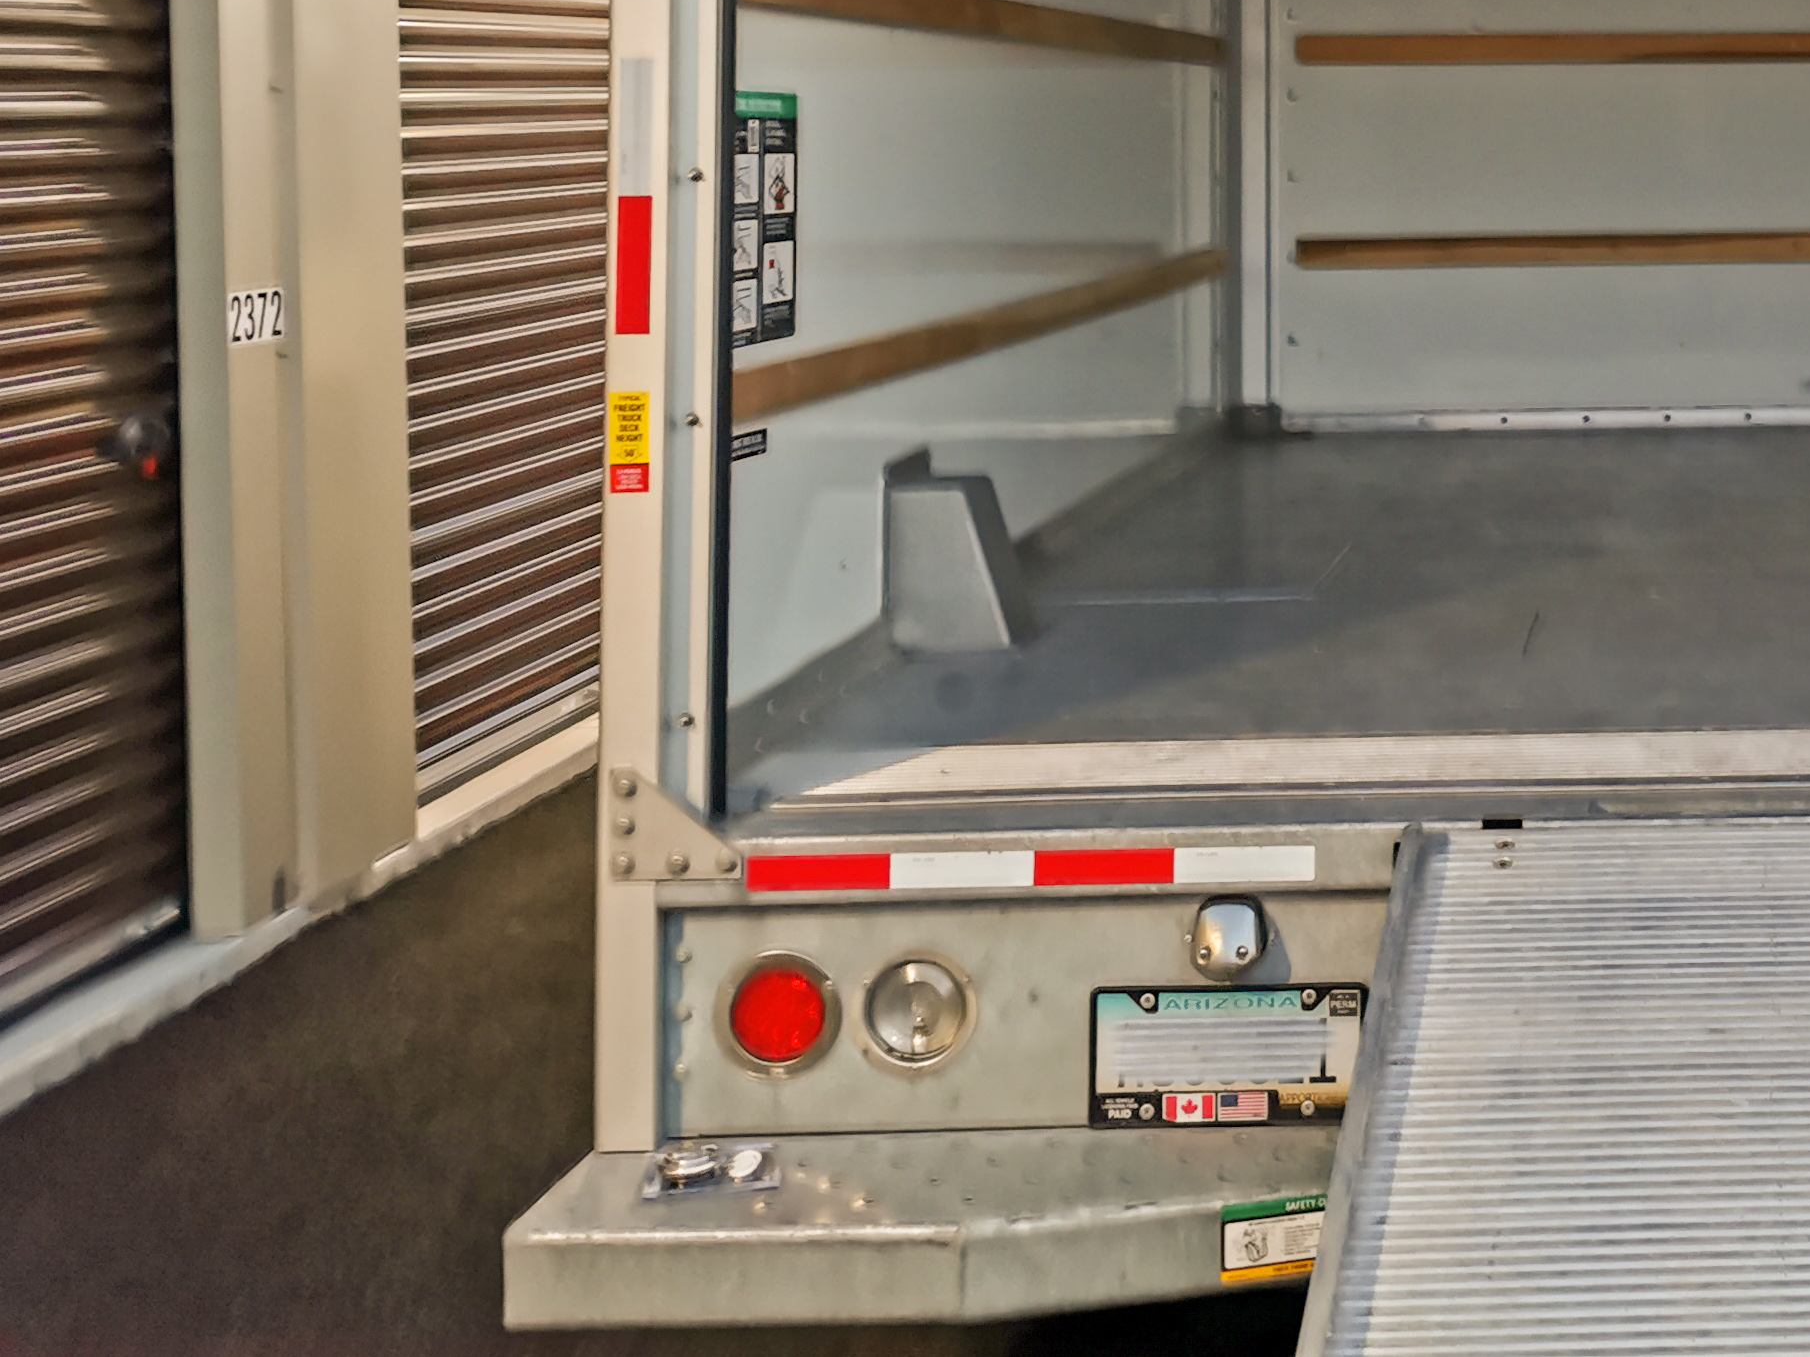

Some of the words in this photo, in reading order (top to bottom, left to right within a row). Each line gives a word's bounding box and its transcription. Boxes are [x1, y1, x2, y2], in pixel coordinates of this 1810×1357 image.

[231, 290, 282, 342] 2372
[613, 404, 646, 412] FREIGHT
[617, 414, 642, 422] TRUCK
[1163, 995, 1298, 1011] ARIZONA
[1108, 1108, 1132, 1120] PAID
[1285, 1199, 1316, 1212] SAFETY
